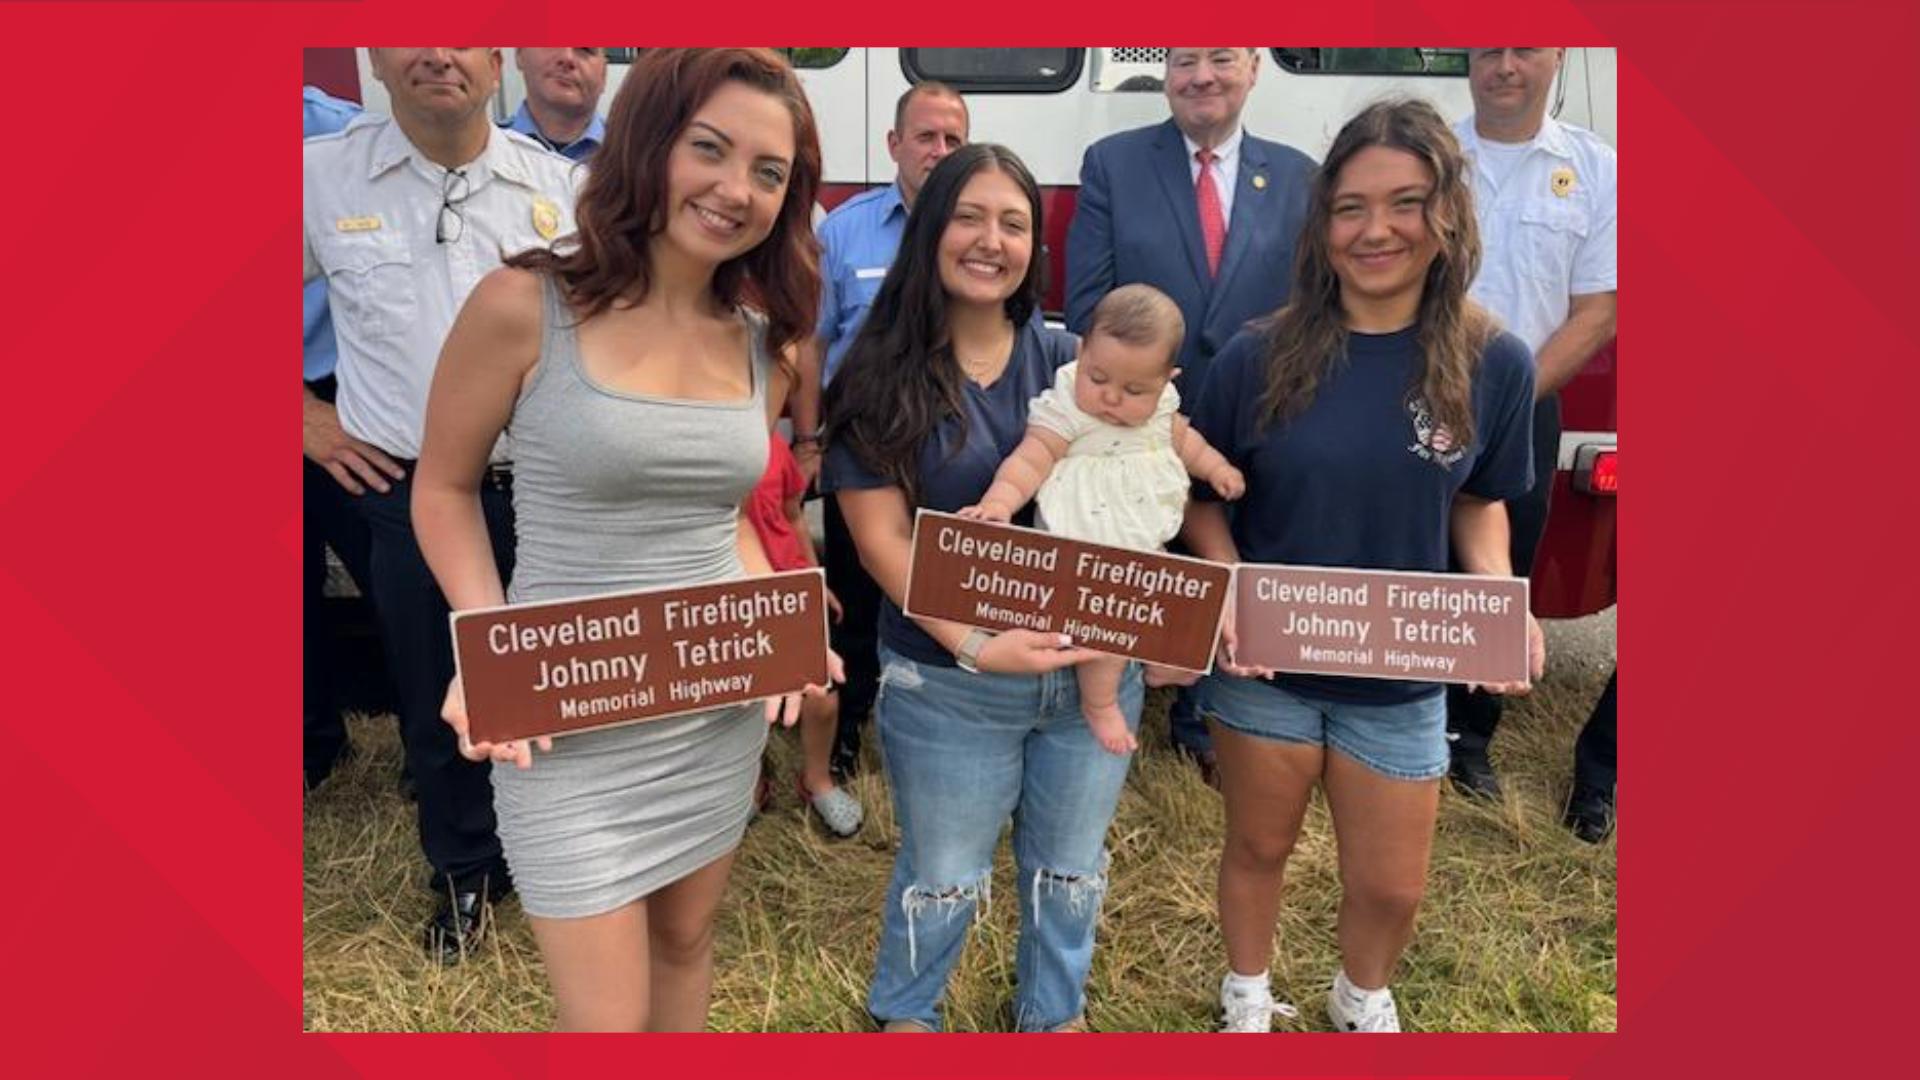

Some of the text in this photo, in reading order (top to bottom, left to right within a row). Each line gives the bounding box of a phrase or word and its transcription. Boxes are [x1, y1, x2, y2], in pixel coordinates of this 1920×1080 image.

[939, 526, 1212, 599] Cleveland Firefighter
[960, 567, 1165, 627] Johnny Tetrick
[1256, 577, 1512, 618] Cleveland Firefighter
[488, 590, 808, 654] Cleveland Firefighter
[975, 602, 1139, 650] Memorial Highway
[1282, 611, 1476, 646] Johnny Tetrick
[533, 630, 773, 691] Johnny Tetrick
[1300, 646, 1456, 672] Memorial Highway
[560, 672, 753, 720] Memorial Highway
